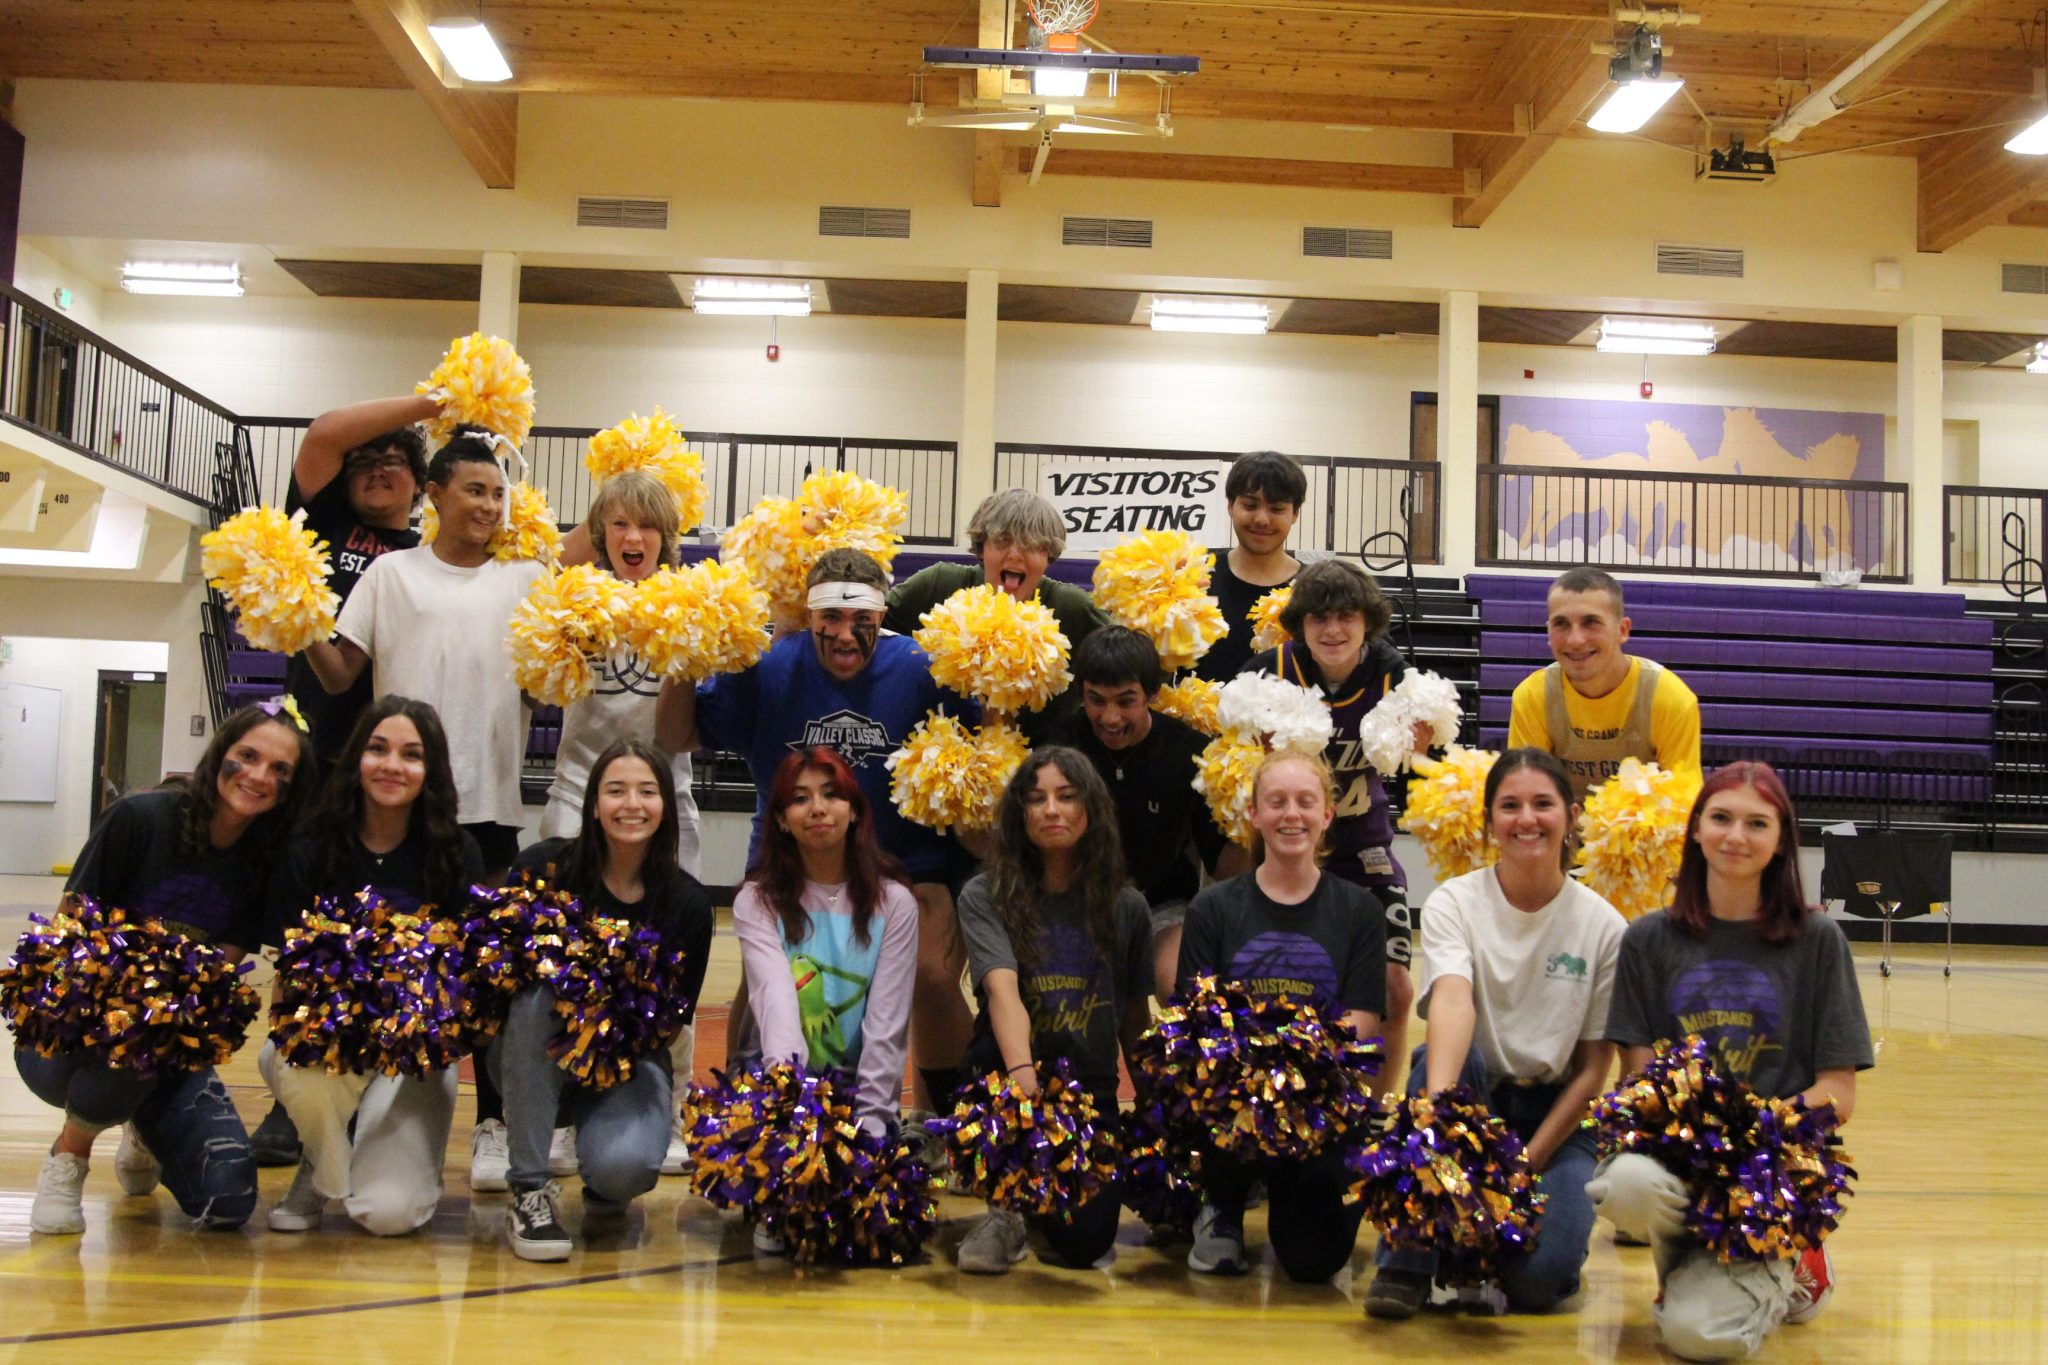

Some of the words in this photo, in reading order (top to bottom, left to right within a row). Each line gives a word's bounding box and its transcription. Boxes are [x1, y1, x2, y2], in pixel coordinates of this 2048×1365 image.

[1047, 470, 1219, 498] VISITORS
[54, 494, 69, 504] 400
[1063, 503, 1206, 533] SEATING
[806, 726, 843, 746] VALLEY
[845, 727, 886, 747] CLASSIC
[1677, 1010, 1754, 1033] MUSTANGS
